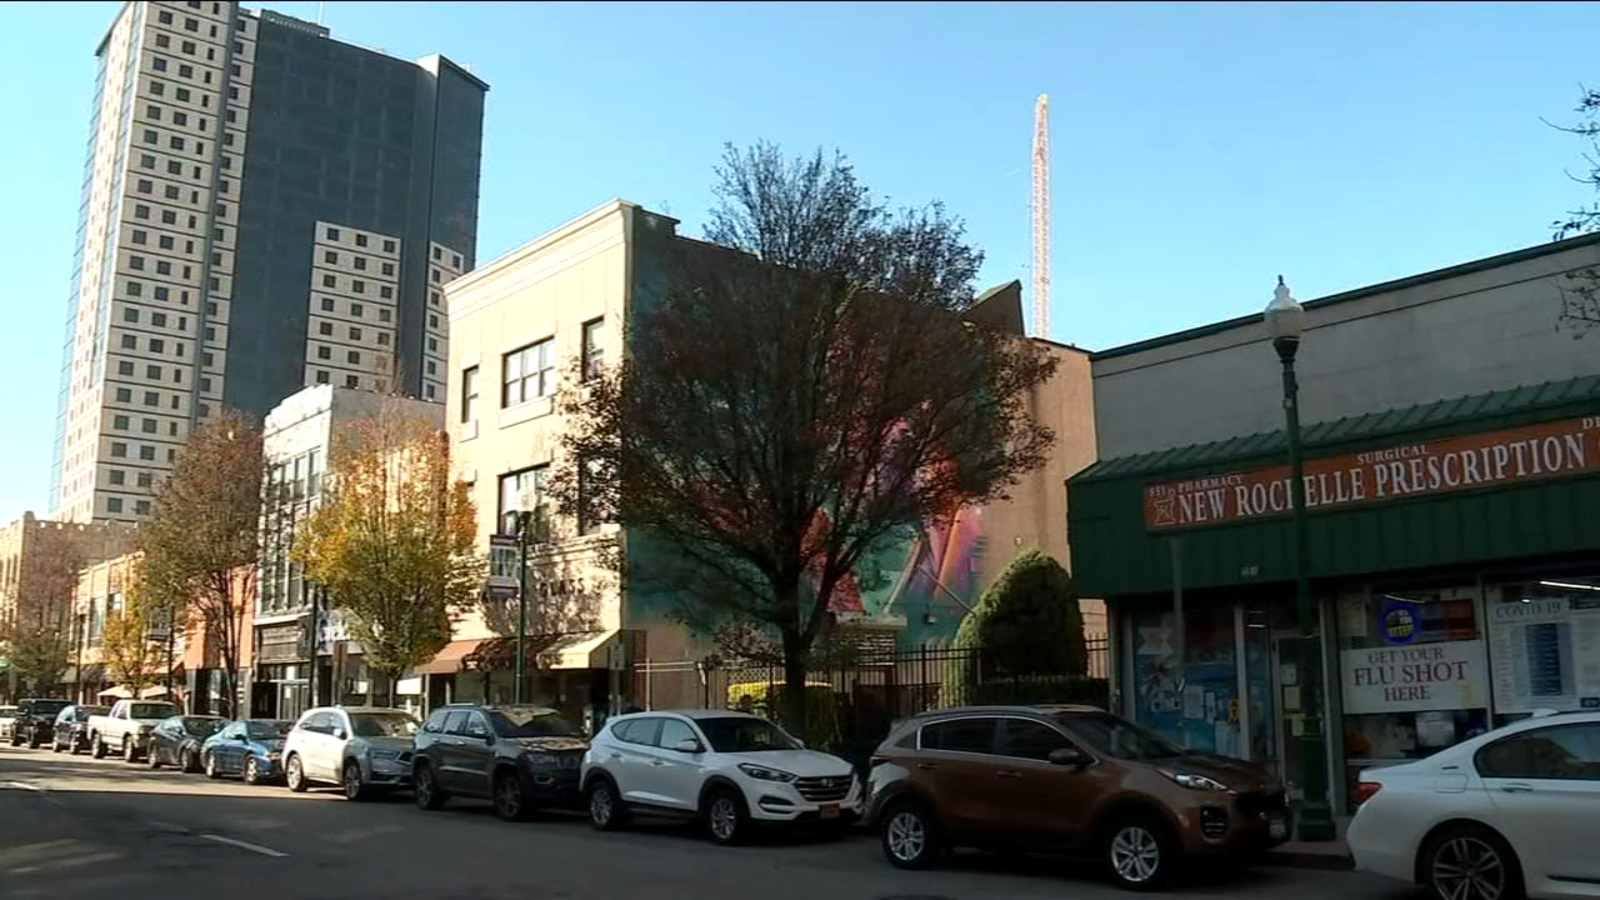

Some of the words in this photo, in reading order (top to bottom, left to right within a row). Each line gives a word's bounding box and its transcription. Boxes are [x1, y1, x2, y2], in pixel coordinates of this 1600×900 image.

[1357, 444, 1429, 465] SURGICAL
[1177, 474, 1242, 492] PHARMACY
[1178, 489, 1226, 524] NEW
[1374, 432, 1586, 497] PRESCRIPTION
[1368, 650, 1398, 664] GET
[1399, 647, 1444, 662] YOUR
[1354, 666, 1395, 686] FLU
[1402, 661, 1467, 683] SHOT
[1384, 685, 1430, 701] HERE
